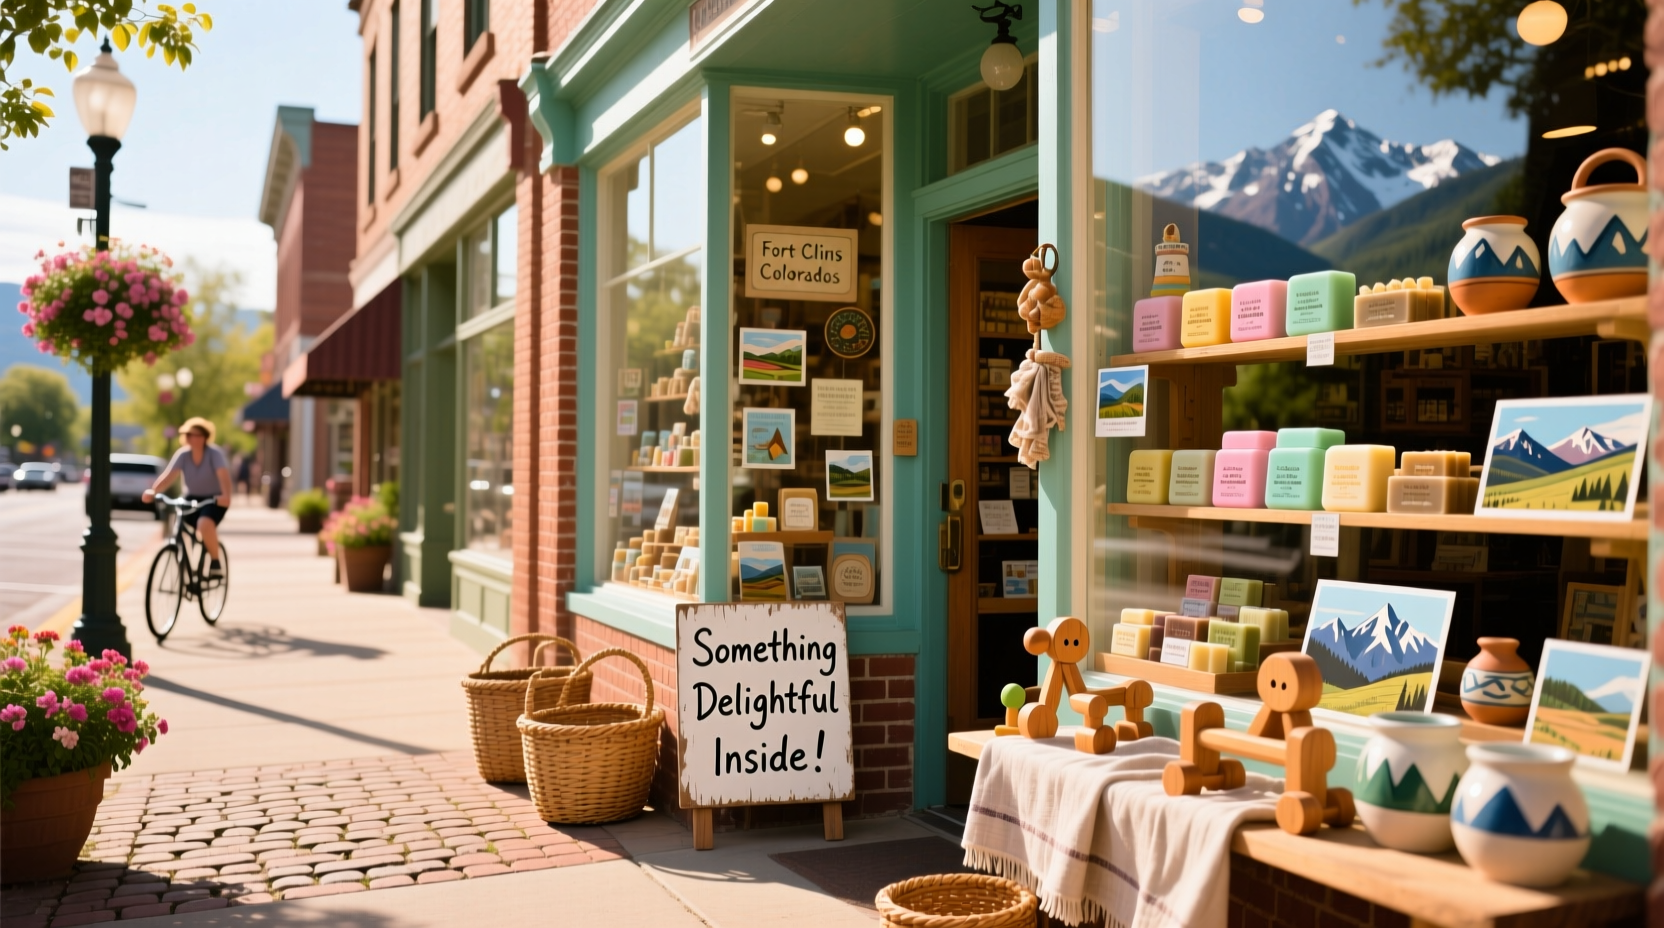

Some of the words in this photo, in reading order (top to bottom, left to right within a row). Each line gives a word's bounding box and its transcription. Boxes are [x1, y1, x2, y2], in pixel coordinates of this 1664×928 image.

[760, 262, 841, 284] Colorados
[762, 240, 796, 259] Fort
[801, 243, 843, 262] Clins
[692, 627, 837, 677] Something
[692, 679, 839, 731] Delightful
[715, 729, 826, 777] Inside!
